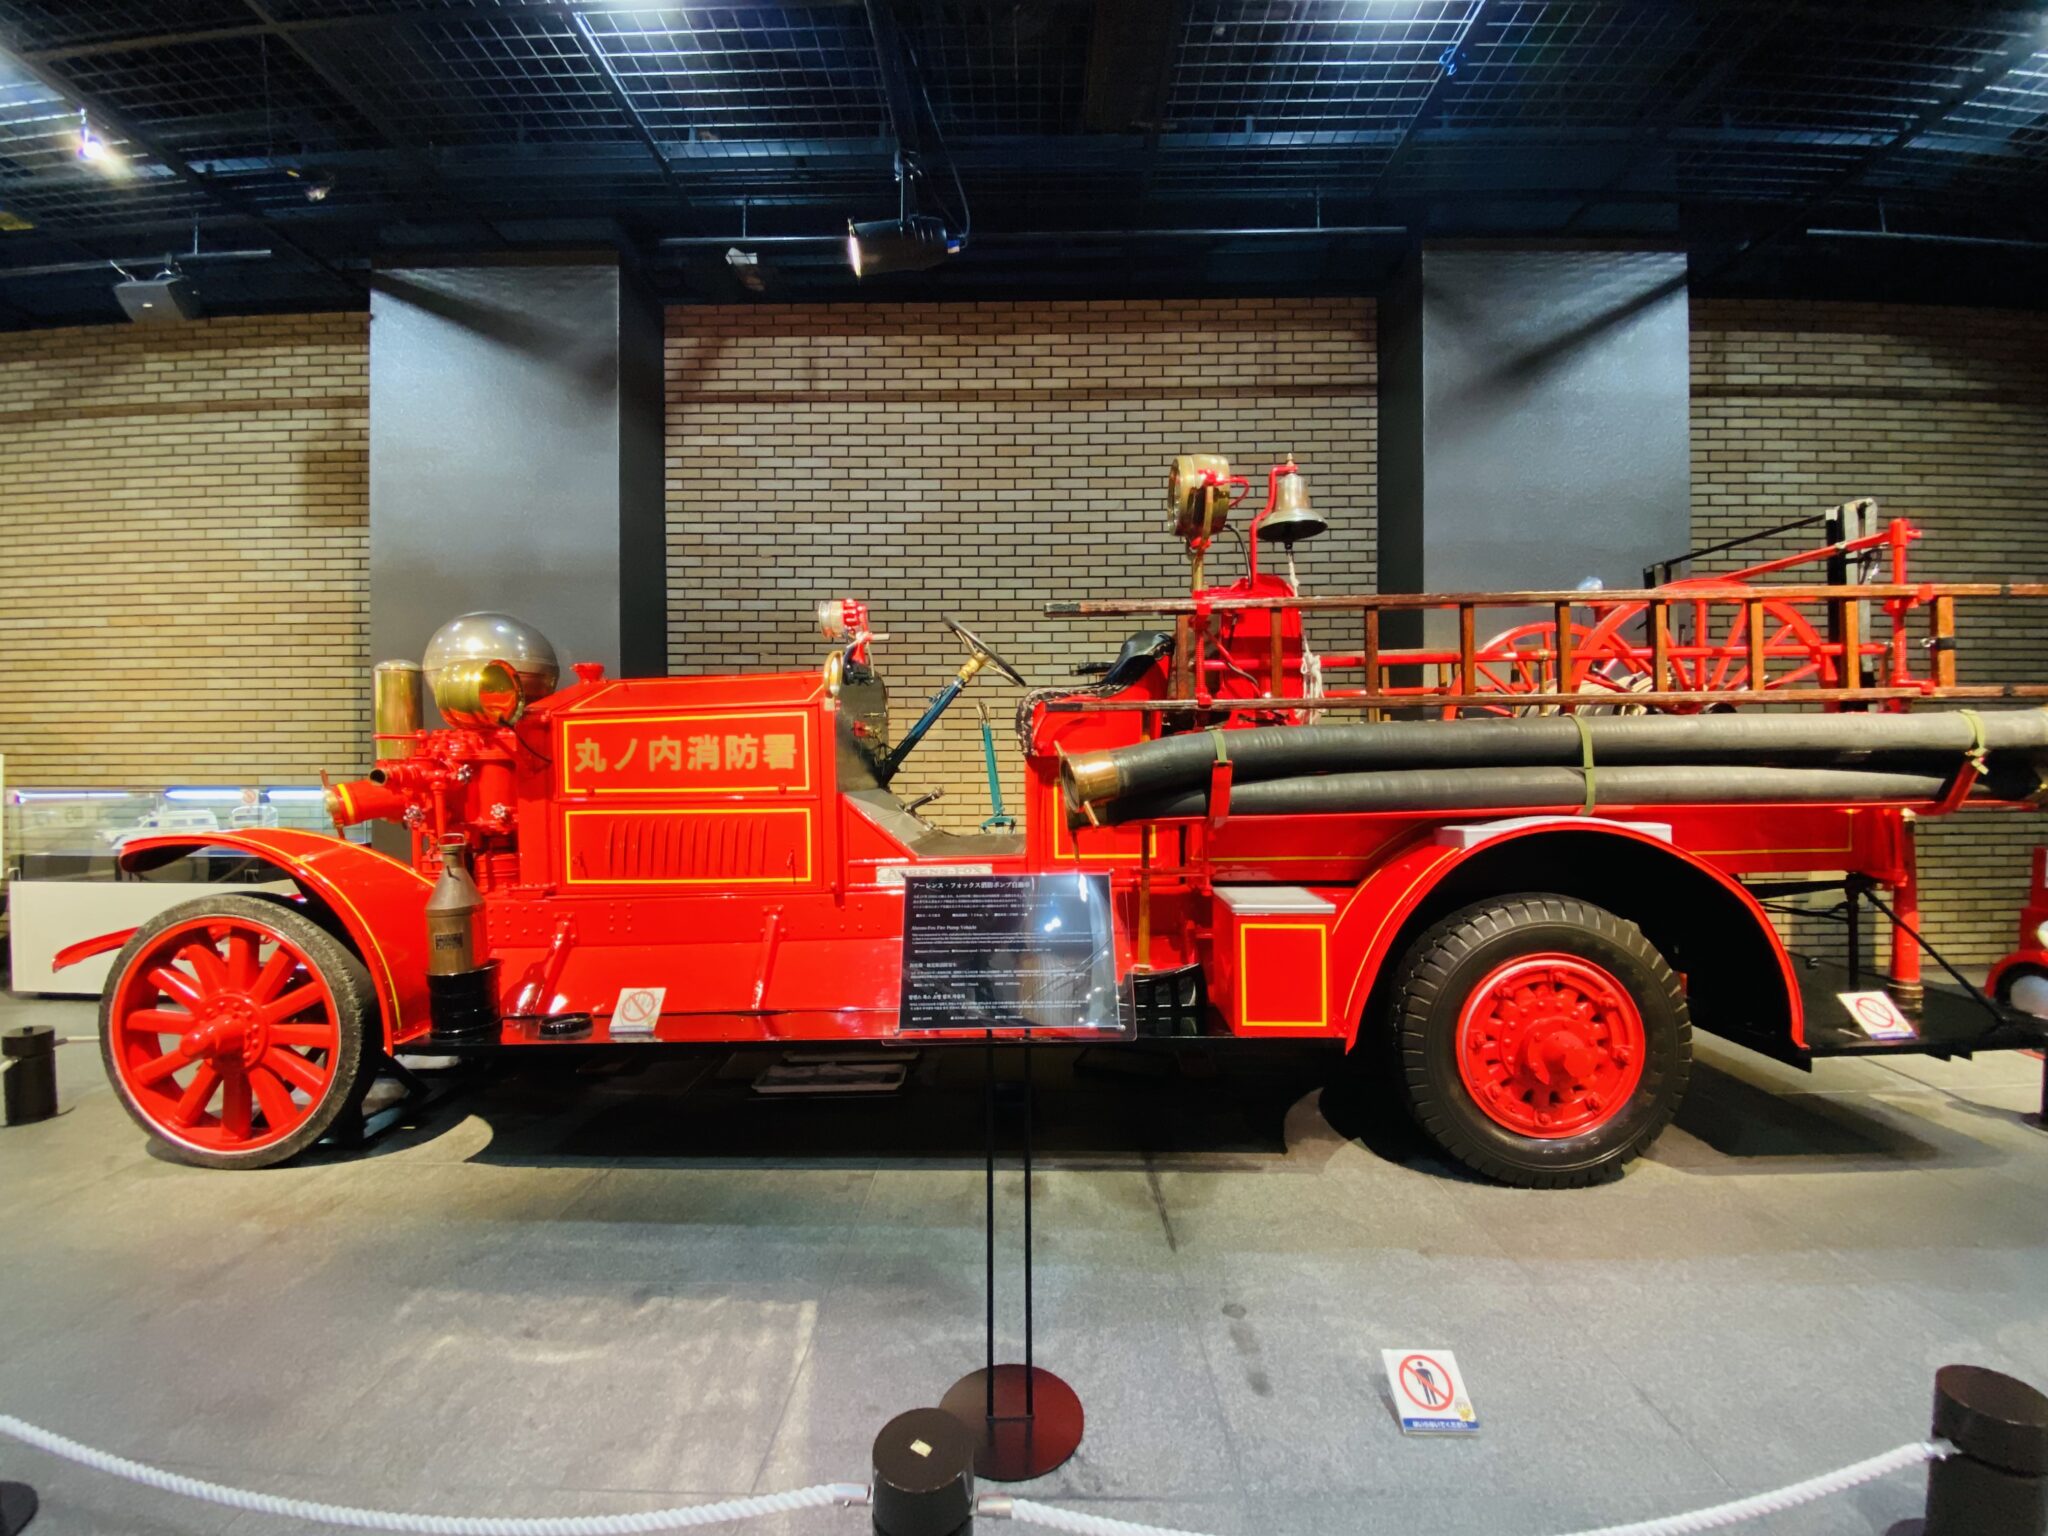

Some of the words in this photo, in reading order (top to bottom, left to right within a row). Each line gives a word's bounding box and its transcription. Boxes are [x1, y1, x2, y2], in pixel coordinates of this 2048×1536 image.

[575, 733, 797, 772] 丸ノ内消防署
